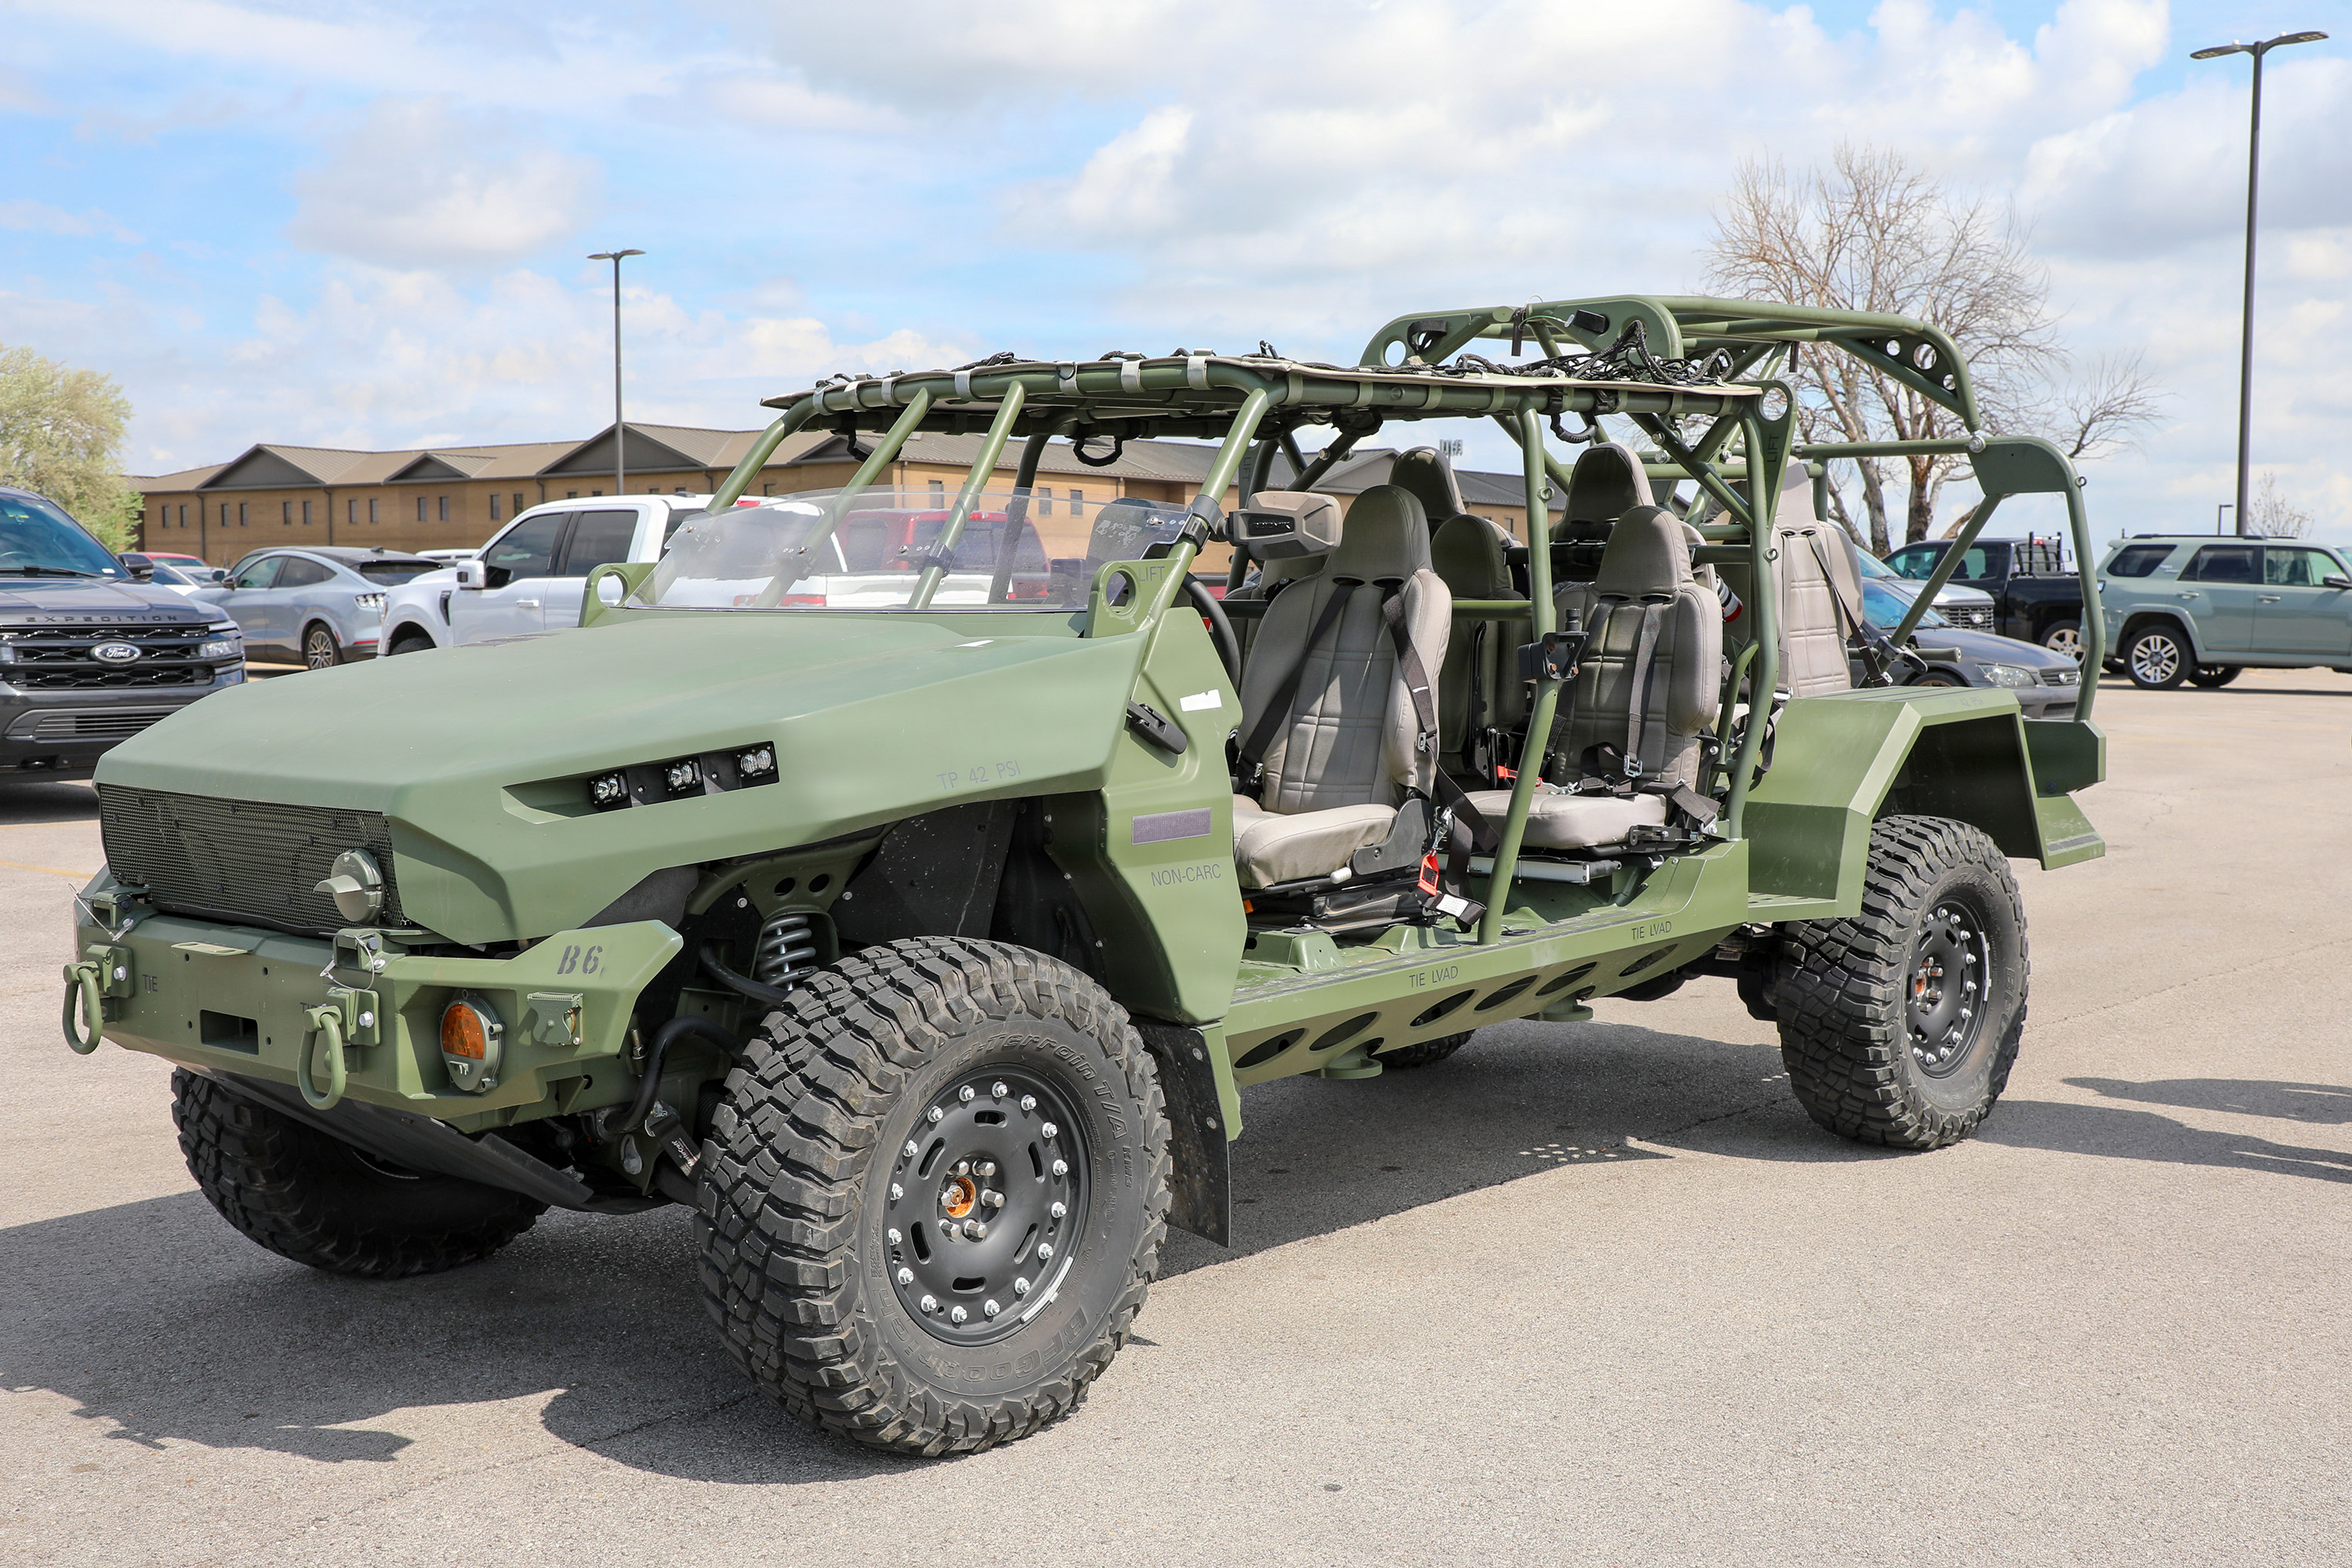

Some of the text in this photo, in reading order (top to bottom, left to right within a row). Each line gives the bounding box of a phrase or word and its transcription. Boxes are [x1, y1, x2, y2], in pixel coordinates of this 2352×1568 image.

[1767, 434, 1779, 462] LIFT
[1138, 566, 1165, 582] LIFT
[106, 648, 131, 658] Ford
[936, 760, 1021, 789] TP 42 PSI
[1151, 863, 1221, 887] NON-CARC
[1632, 920, 1672, 940] TIE LVAD
[142, 974, 158, 992] TIE
[1409, 966, 1458, 988] TIE LVAD
[1094, 1080, 1128, 1139] T/A
